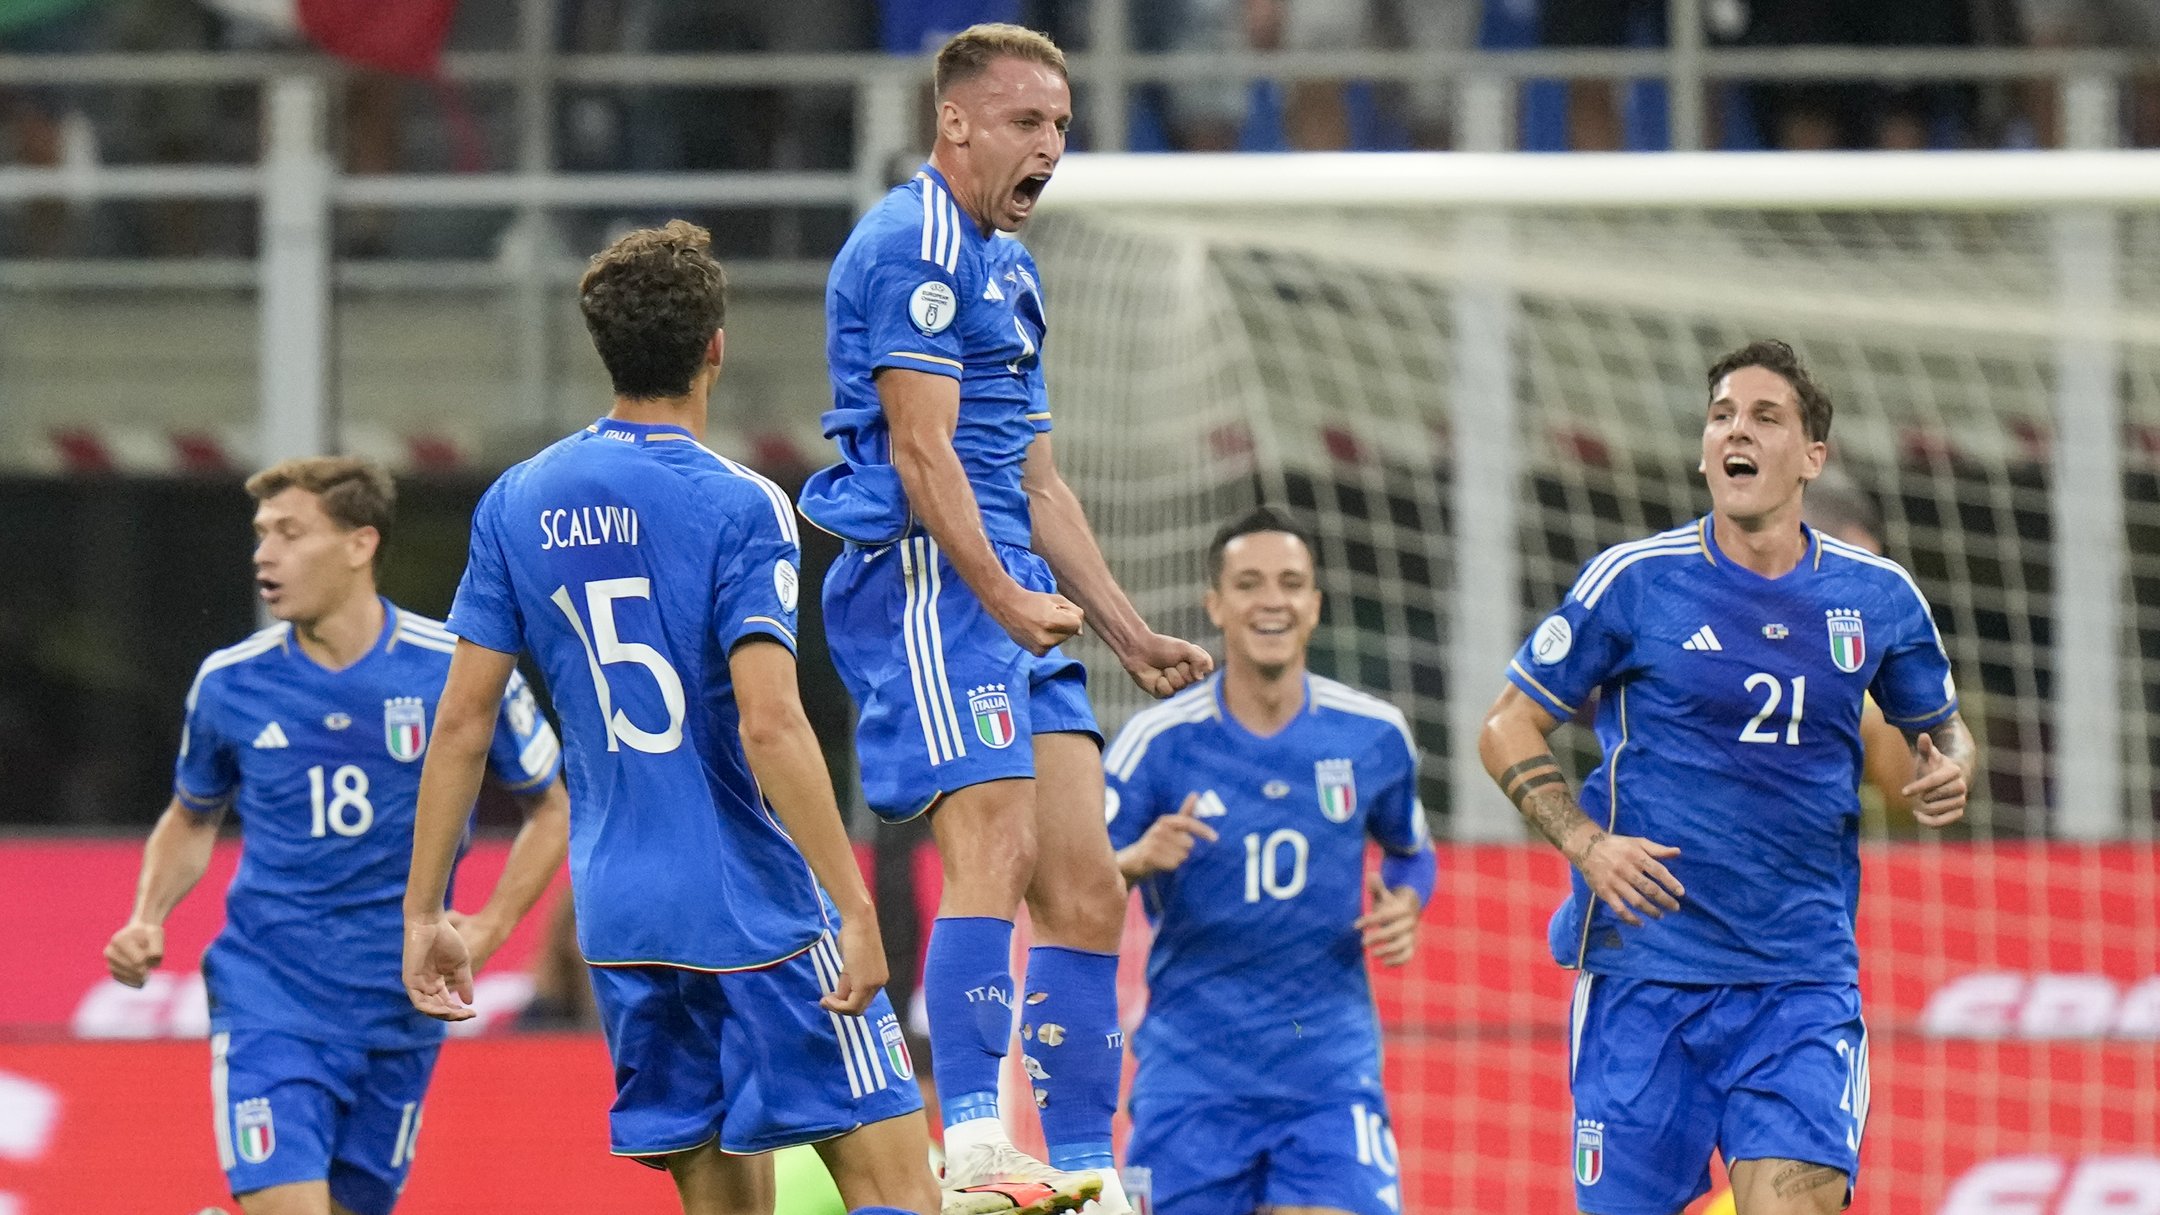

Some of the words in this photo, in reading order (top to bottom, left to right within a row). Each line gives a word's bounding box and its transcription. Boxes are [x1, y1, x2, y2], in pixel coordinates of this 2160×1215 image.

[603, 430, 636, 443] ITALIA
[1831, 620, 1861, 632] ITALIA
[550, 577, 686, 753] 15
[973, 697, 1006, 712] ITALIA
[1738, 672, 1806, 745] 21
[307, 764, 375, 838] 18
[1243, 828, 1310, 903] 10
[1350, 1103, 1400, 1177] 10
